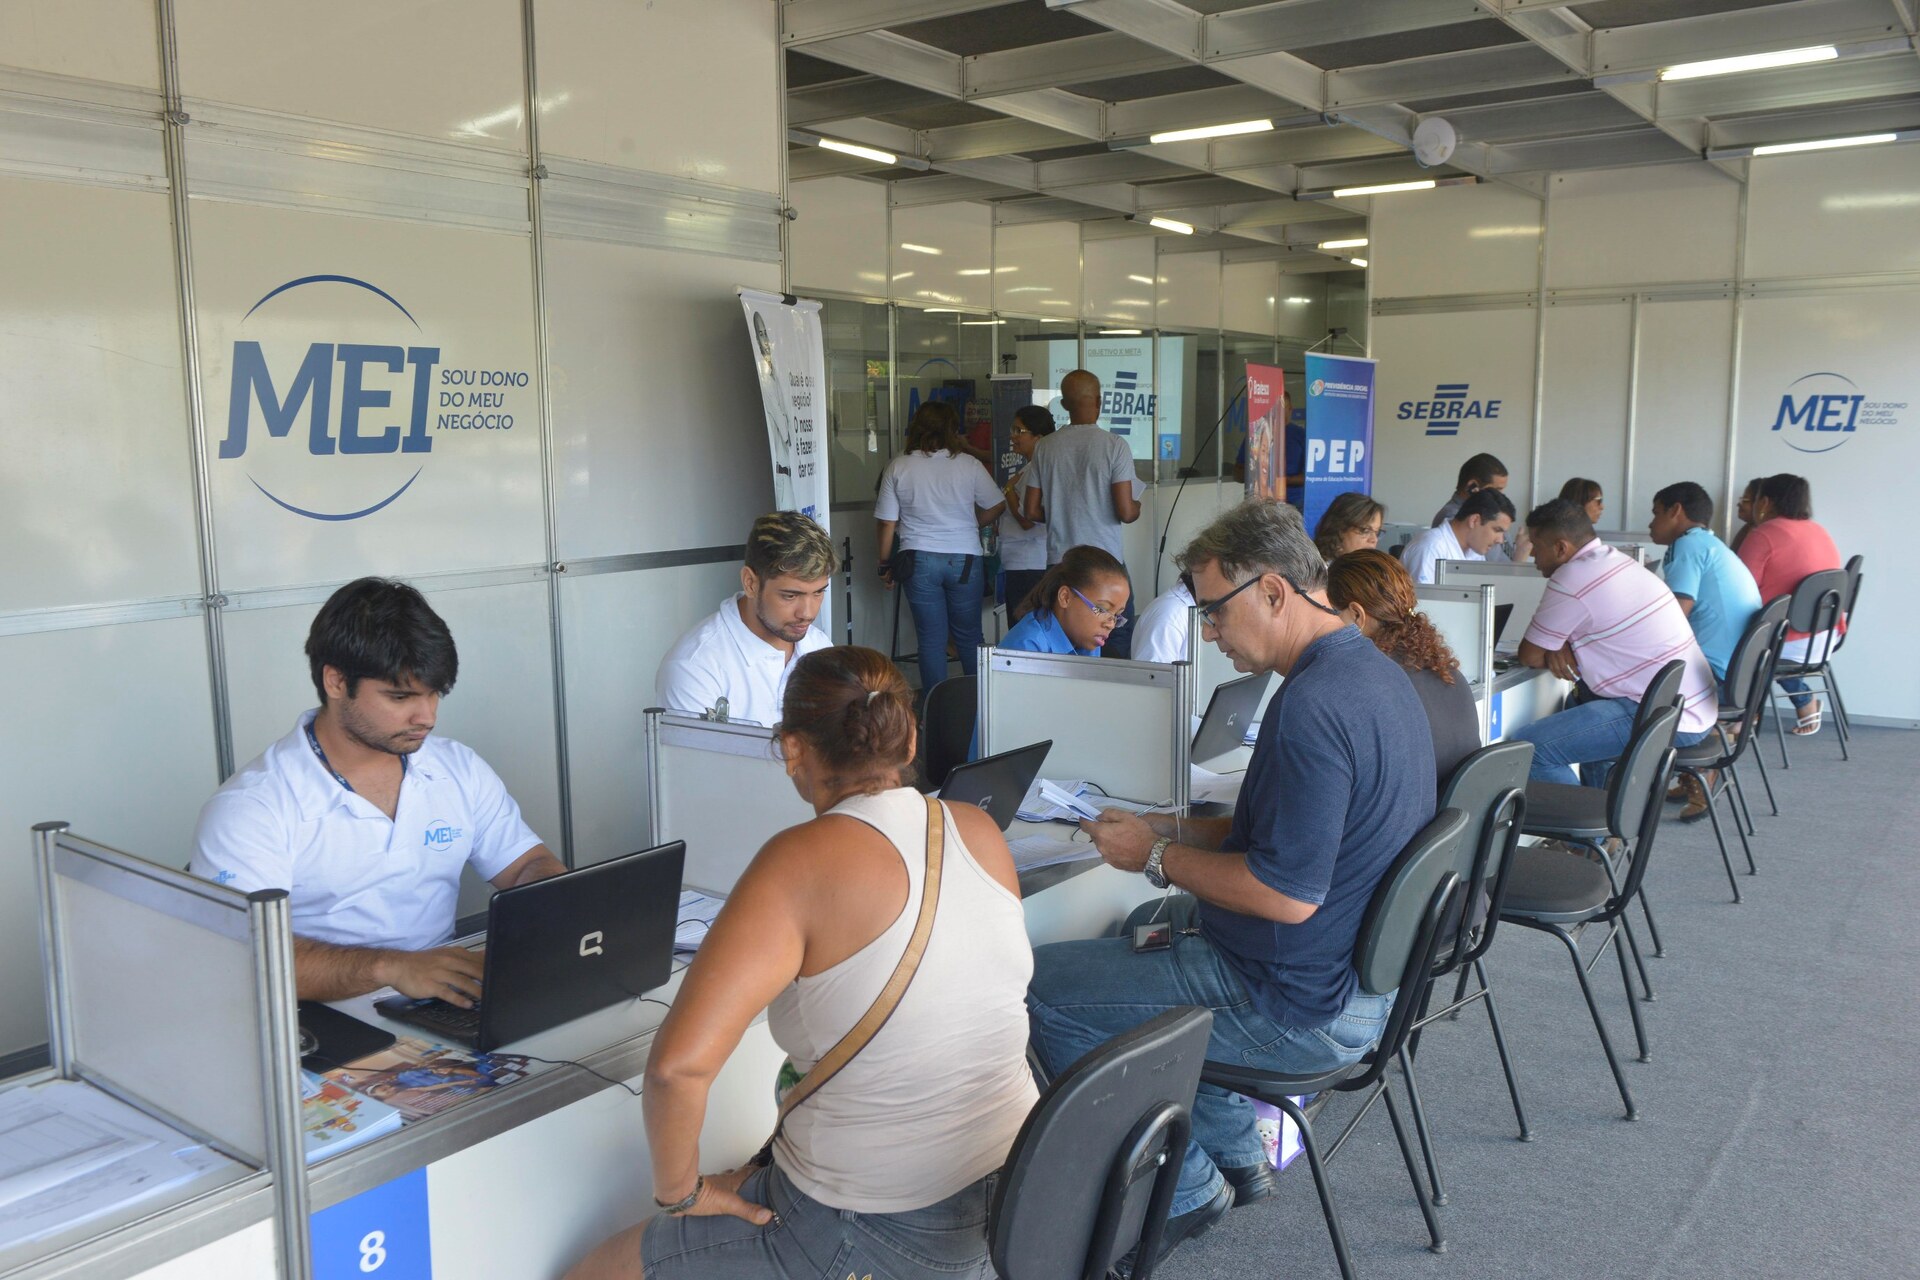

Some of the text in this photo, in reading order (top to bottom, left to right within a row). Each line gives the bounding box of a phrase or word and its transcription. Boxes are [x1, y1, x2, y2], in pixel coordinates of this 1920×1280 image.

[441, 369, 529, 388] SOU DONO
[218, 340, 441, 460] MEI
[439, 391, 505, 408] DO MEU
[1099, 391, 1158, 416] EBRAE
[1396, 400, 1502, 420] SEBRAE
[1771, 394, 1865, 432] MEI
[436, 411, 514, 430] NEGÓCIO
[1000, 452, 1023, 469] SEBRAE
[1306, 438, 1365, 473] PEP
[423, 826, 453, 846] MEI
[358, 1229, 387, 1273] 8
